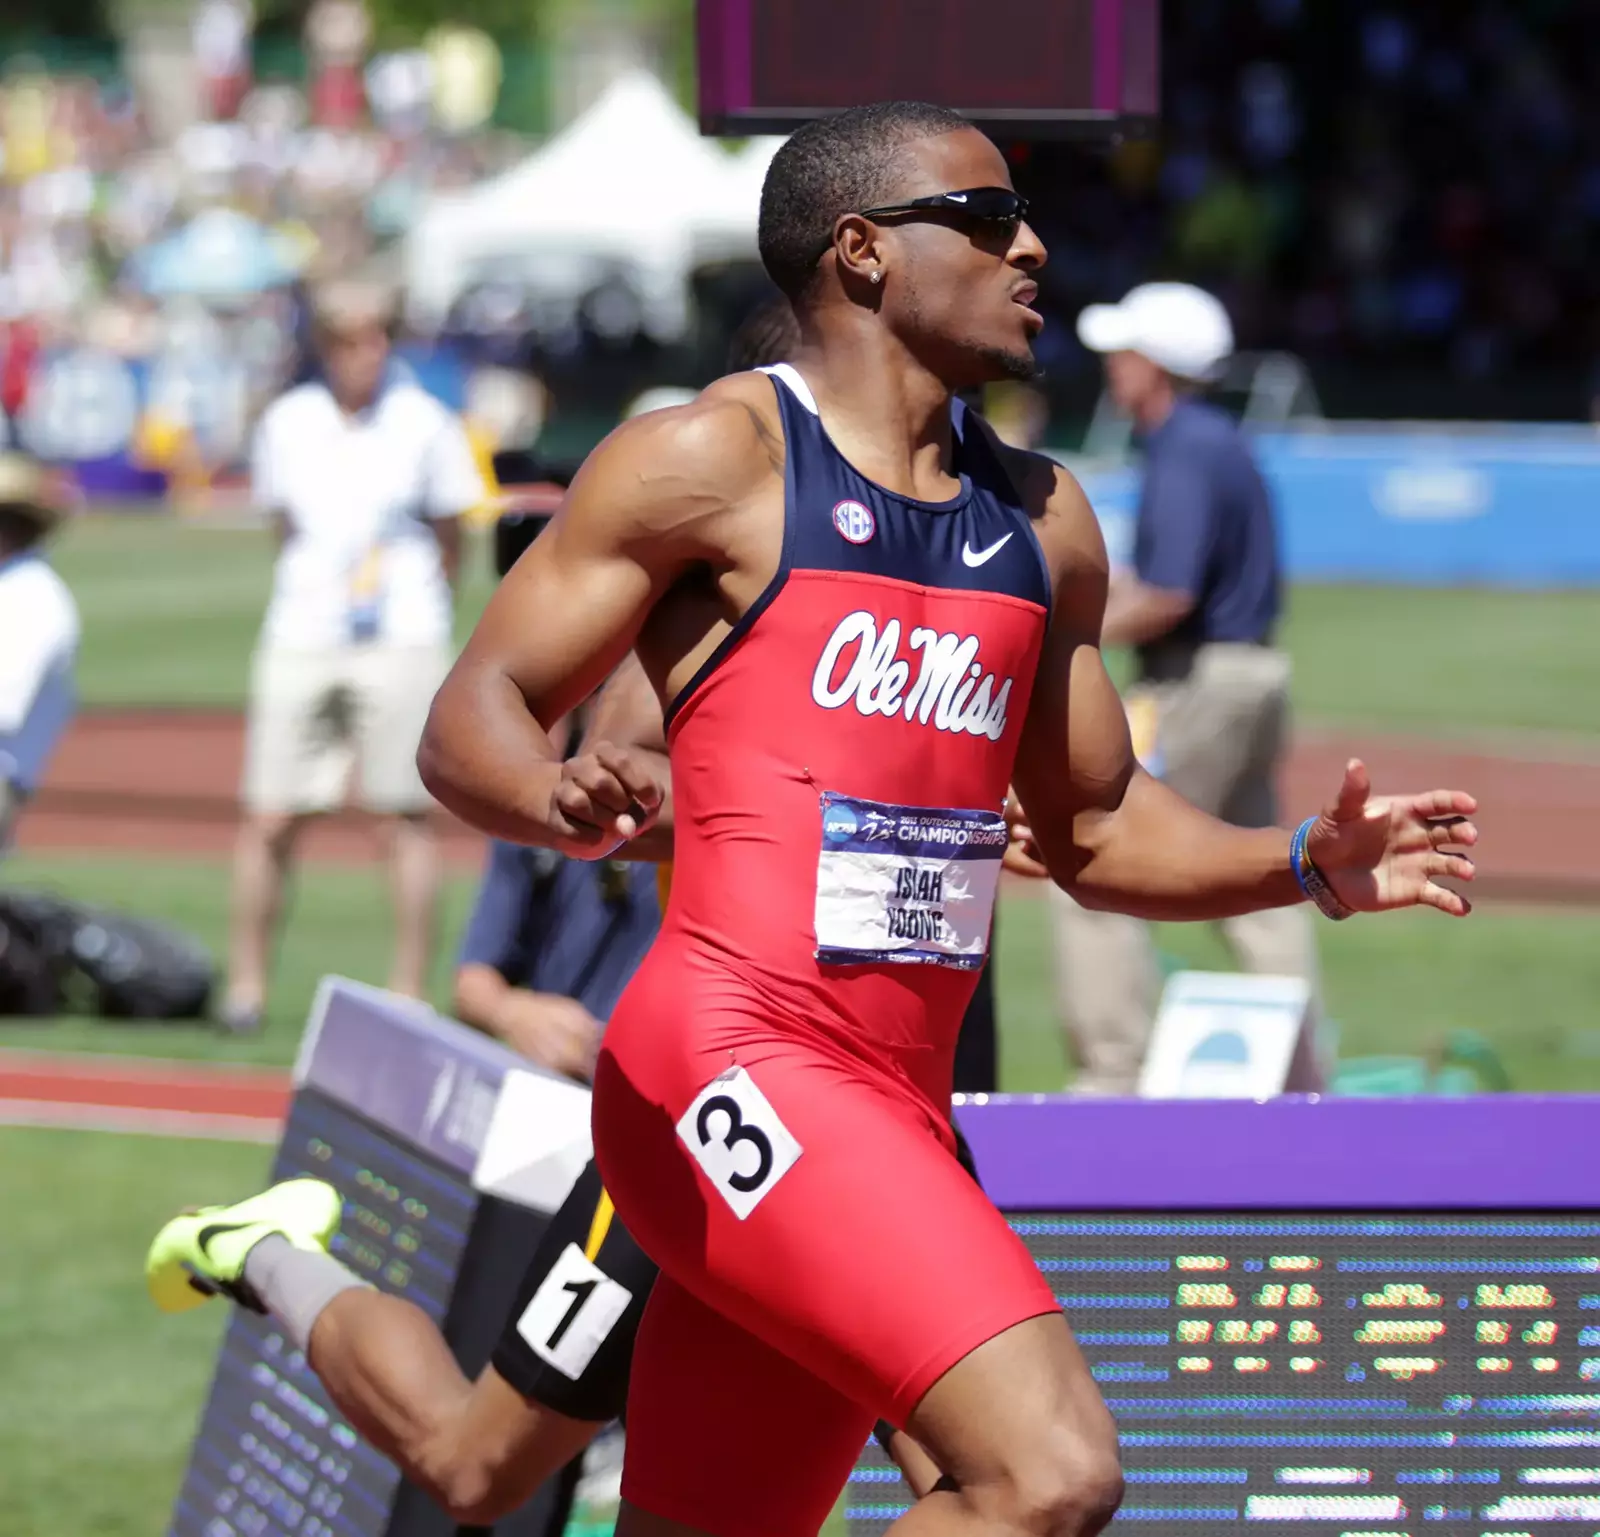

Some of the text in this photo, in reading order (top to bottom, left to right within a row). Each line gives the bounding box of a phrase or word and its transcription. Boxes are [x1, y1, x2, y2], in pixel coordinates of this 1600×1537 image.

[835, 501, 873, 541] SEC
[812, 610, 1013, 741] Ole Miss
[897, 825, 1006, 846] CHAMPIONSHIPS
[919, 817, 961, 828] OUTDOOR
[894, 867, 943, 902] ISIAH
[696, 1094, 773, 1192] 3
[545, 1280, 599, 1351] 1
